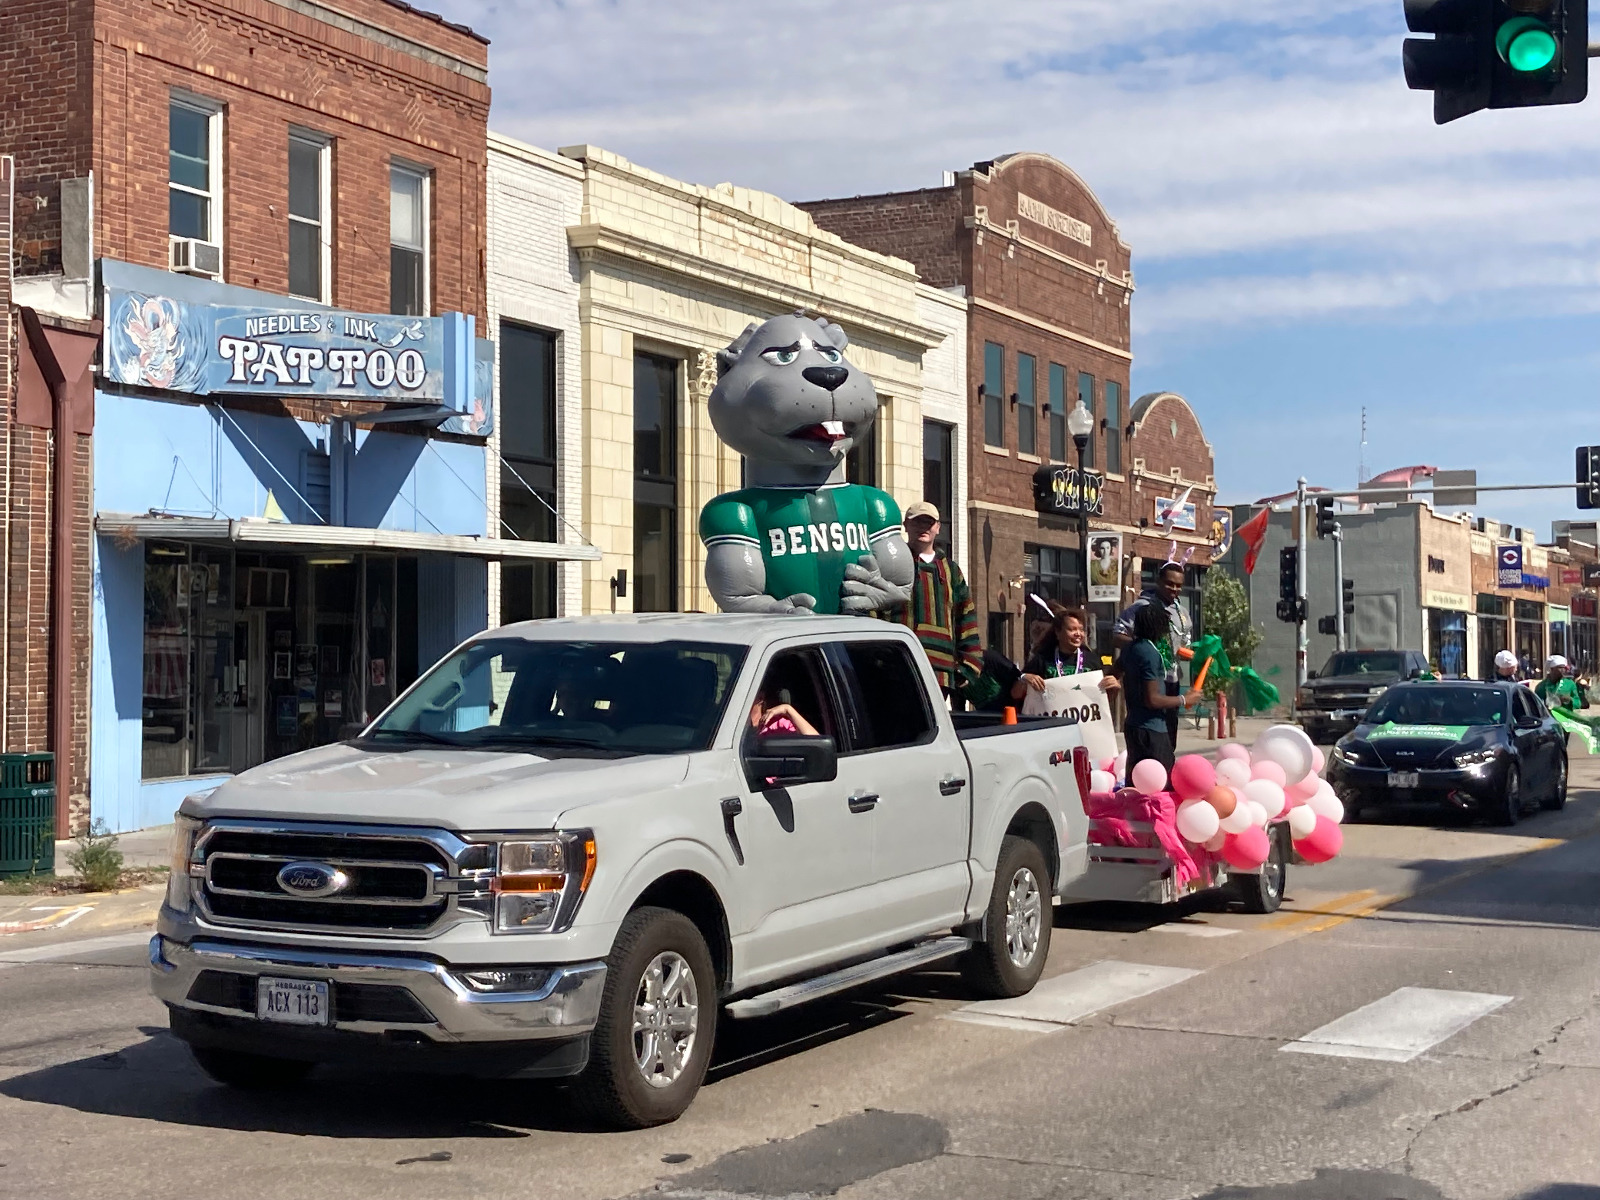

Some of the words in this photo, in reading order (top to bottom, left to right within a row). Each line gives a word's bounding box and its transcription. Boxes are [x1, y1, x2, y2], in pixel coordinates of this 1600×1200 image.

[245, 313, 321, 339] NEEDLES
[344, 316, 379, 341] INK
[218, 335, 428, 391] TATTOO
[768, 522, 871, 557] BENSON
[290, 871, 320, 887] Ford
[267, 990, 290, 1013] ACX
[297, 993, 318, 1016] 113
